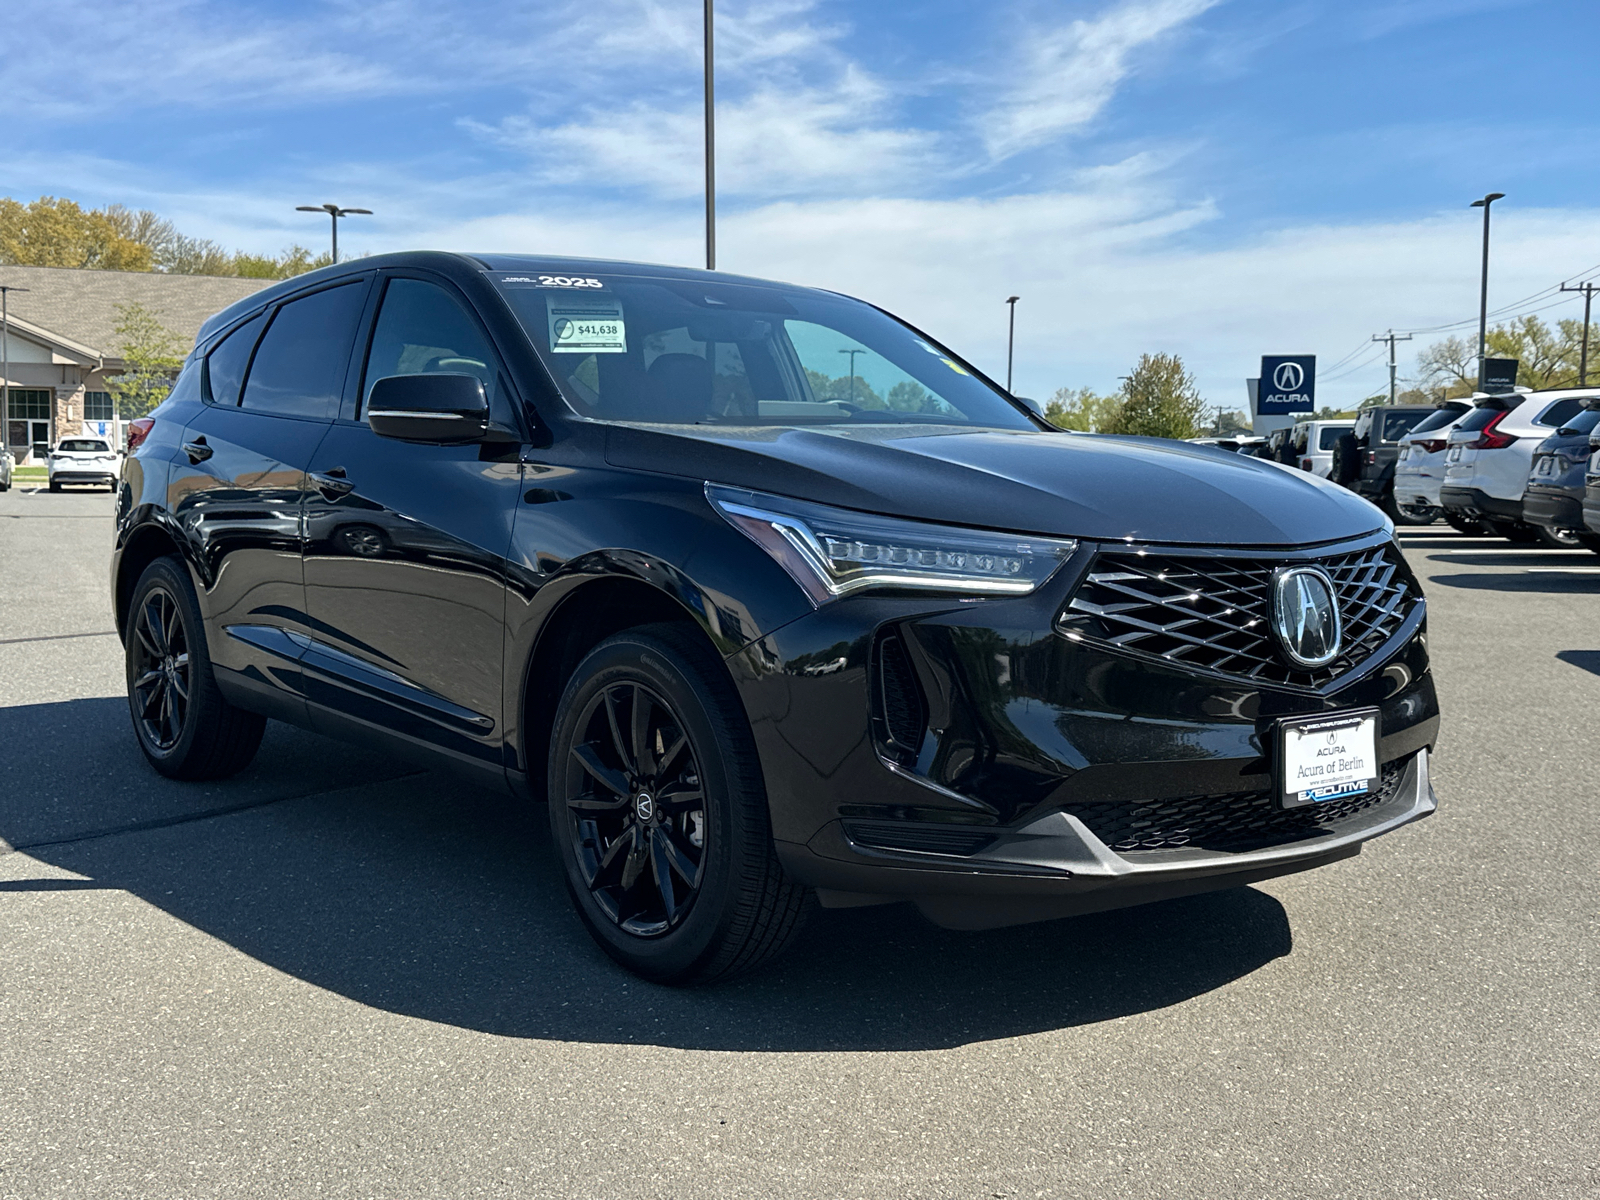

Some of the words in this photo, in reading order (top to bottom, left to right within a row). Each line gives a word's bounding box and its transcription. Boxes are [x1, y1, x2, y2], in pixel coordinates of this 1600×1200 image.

[539, 276, 603, 288] 2025
[578, 325, 618, 336] $41,638
[1265, 393, 1310, 403] ACURA
[1317, 746, 1346, 757] ACURA
[1297, 765, 1324, 778] Acura
[1326, 761, 1336, 773] of
[1338, 756, 1364, 772] Berlin
[1298, 779, 1368, 801] EXECUTIVE
